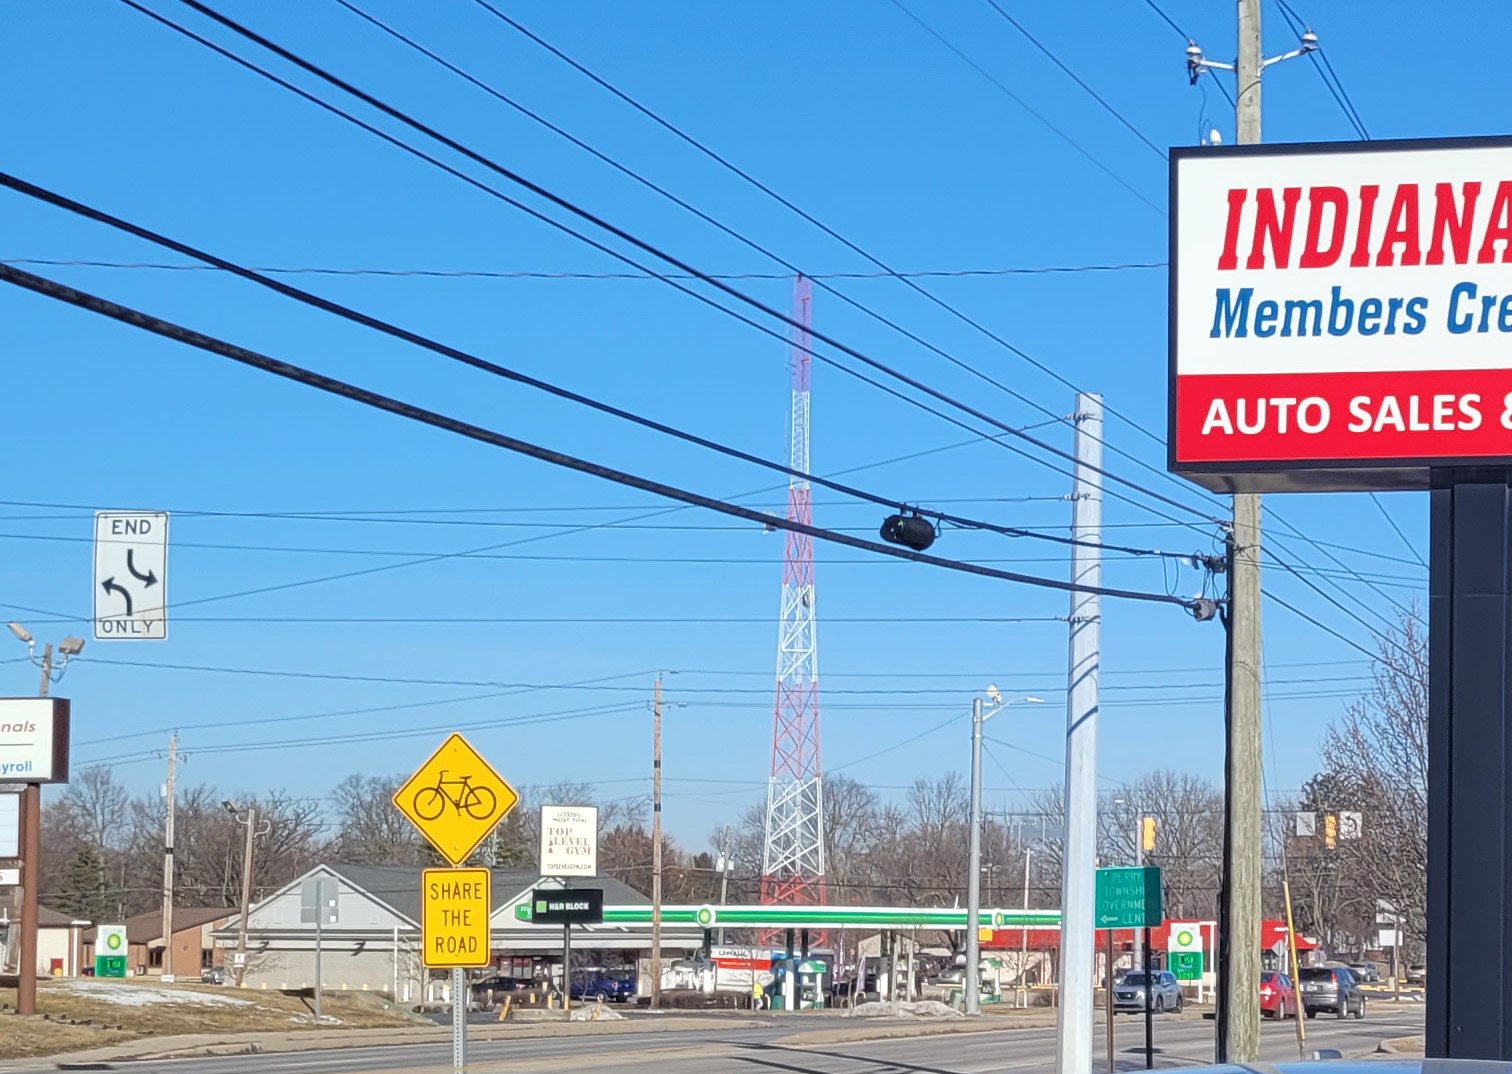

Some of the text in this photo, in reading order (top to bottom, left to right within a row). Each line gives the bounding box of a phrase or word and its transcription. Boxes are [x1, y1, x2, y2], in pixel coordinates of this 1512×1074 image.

[1210, 285, 1428, 339] Members
[1201, 397, 1331, 435] AUTO
[1348, 393, 1482, 433] SALES
[112, 519, 151, 535] END
[102, 620, 153, 634] ONLY
[0, 720, 36, 733] nals
[0, 760, 32, 774] yroll
[547, 827, 573, 837] TOP
[554, 836, 591, 847] LEVEL
[566, 846, 591, 856] GYM
[1112, 871, 1142, 883] PERRY
[430, 882, 482, 901] SHARE
[1105, 885, 1145, 898] TOWNSHI
[549, 902, 589, 911] H&R BLOCK
[1096, 898, 1146, 911] GOVERNME
[441, 909, 472, 927] THE
[435, 935, 477, 954] ROAD
